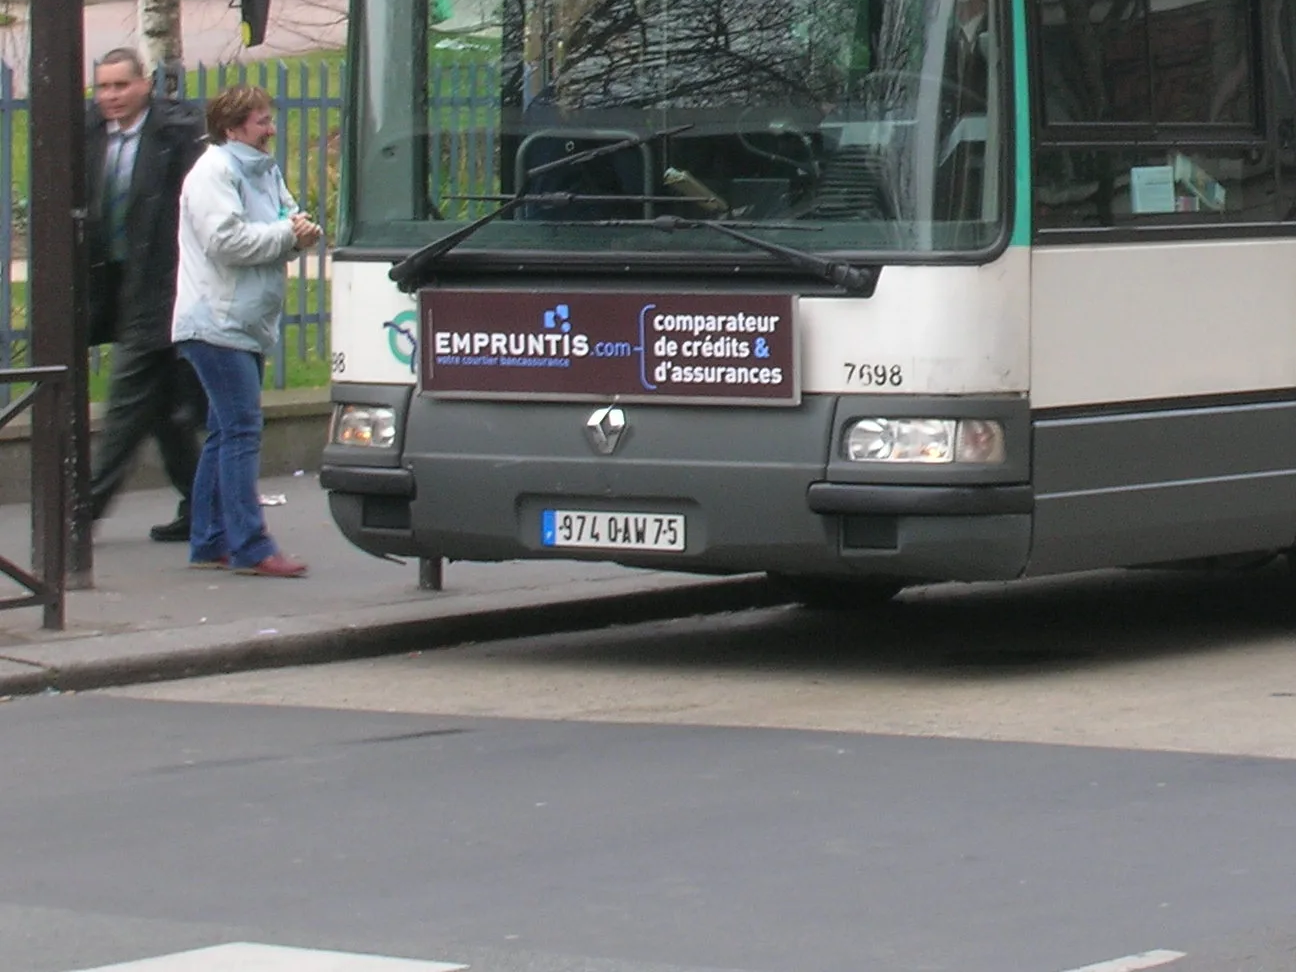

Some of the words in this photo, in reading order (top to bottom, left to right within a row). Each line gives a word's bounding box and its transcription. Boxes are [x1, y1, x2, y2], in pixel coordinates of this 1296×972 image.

[653, 312, 780, 337] comparateur
[434, 331, 632, 359] EMPRUNTIS.com
[653, 335, 678, 357] de
[681, 335, 751, 358] crédits
[754, 336, 771, 359] &
[436, 356, 461, 366] votre
[462, 356, 498, 366] courtier
[500, 357, 570, 368] bancassurance
[653, 360, 783, 385] d'assurances
[843, 361, 903, 387] 7698
